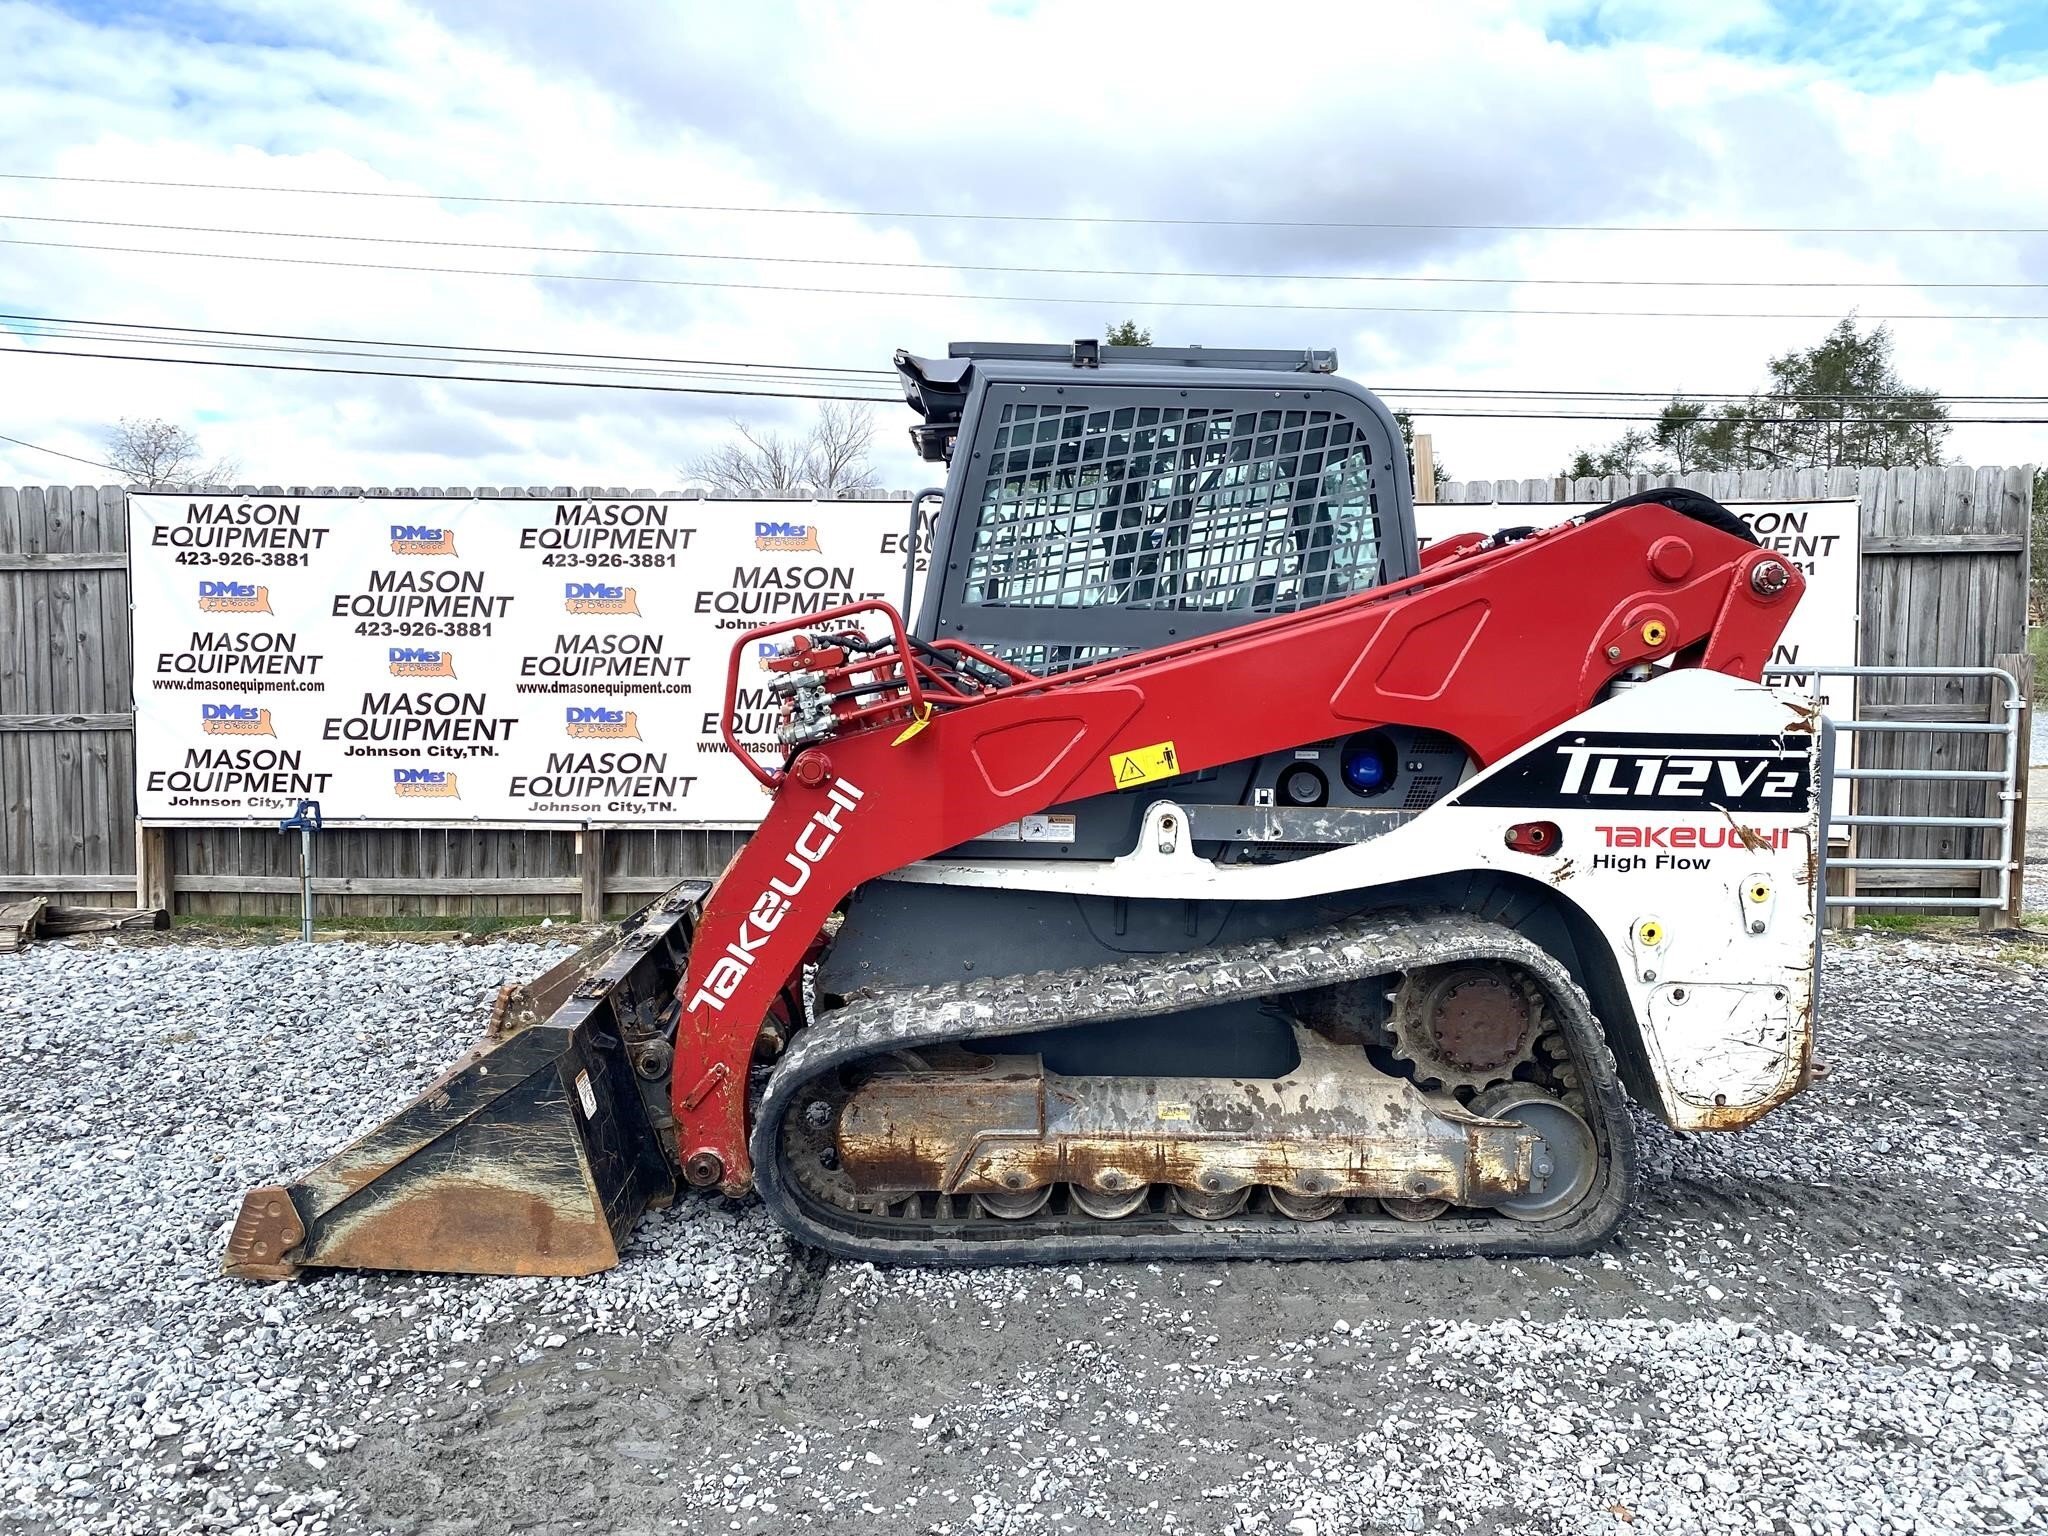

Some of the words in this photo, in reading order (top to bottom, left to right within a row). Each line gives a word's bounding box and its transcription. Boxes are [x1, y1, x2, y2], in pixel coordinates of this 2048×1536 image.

[186, 503, 301, 526] MASON
[554, 504, 668, 527] MASON
[151, 525, 330, 549] EQUIPMENT
[519, 528, 697, 550] EQUIPMENT
[175, 551, 309, 567] 423-926-3881
[541, 553, 676, 568] 423-926-3881
[368, 570, 485, 593] MASON
[732, 566, 855, 590] MASON
[331, 594, 515, 618] EQUIPMENT
[354, 621, 492, 637] 423-926-3881
[190, 631, 297, 653] MASON
[554, 634, 664, 655] MASON
[156, 653, 324, 675] EQUIPMENT
[520, 656, 691, 677] EQUIPMENT
[152, 677, 325, 695] www.dmasonequipment.com
[516, 680, 692, 697] www.dmasonequipment.com
[361, 692, 487, 716] MASON
[322, 717, 519, 741] EQUIPMENT
[184, 748, 302, 771] MASON
[343, 745, 421, 757] Johnson
[546, 752, 668, 775] MASON
[1556, 746, 1809, 798] TL12V2
[146, 770, 333, 794] EQUIPMENT
[508, 776, 698, 798] EQUIPMENT
[168, 796, 241, 807] Johnson
[247, 797, 310, 810] City,T
[528, 801, 601, 812] Johnson
[1592, 854, 1647, 873] High
[1655, 854, 1711, 870] Flow
